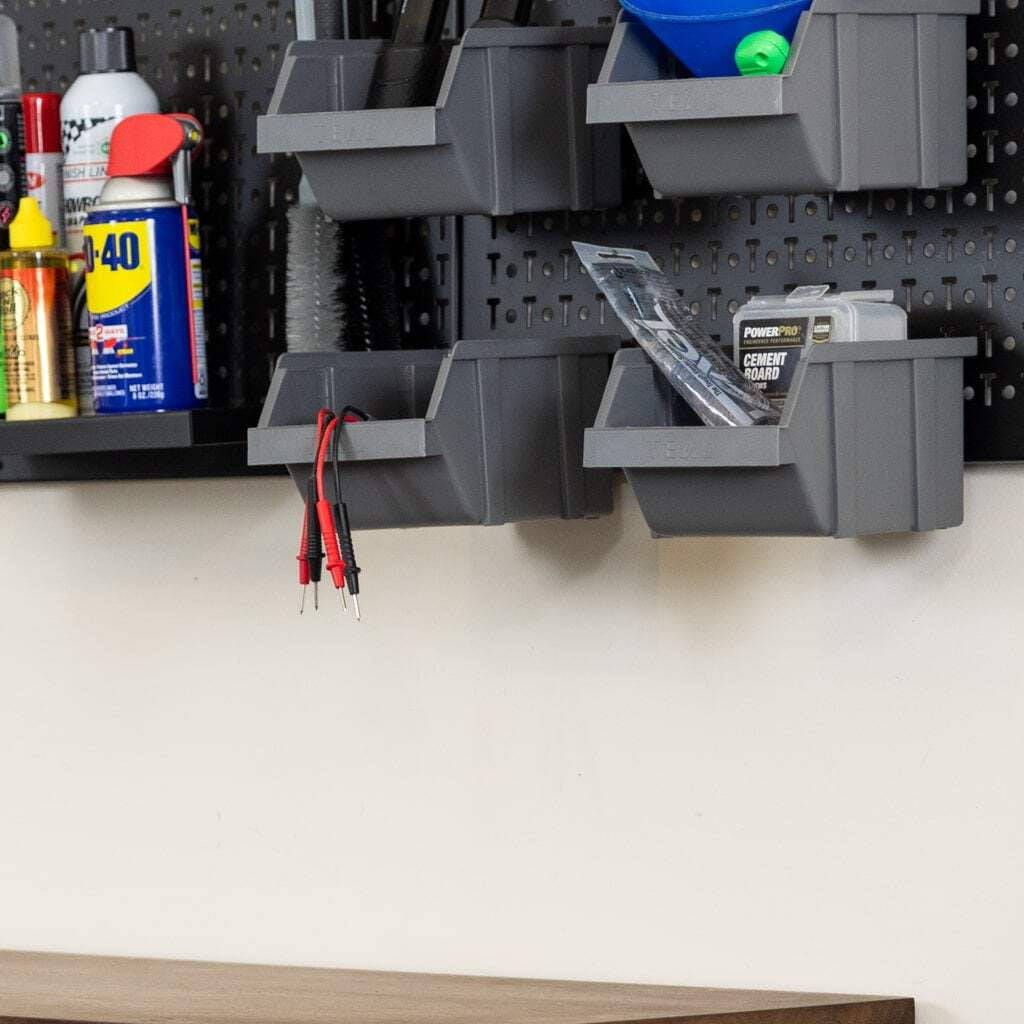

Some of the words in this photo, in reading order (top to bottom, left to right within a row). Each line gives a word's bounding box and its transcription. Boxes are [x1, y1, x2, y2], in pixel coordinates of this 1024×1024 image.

[743, 325, 798, 338] POWERPRO
[743, 351, 788, 367] CEMENT
[744, 366, 780, 381] BOARD
